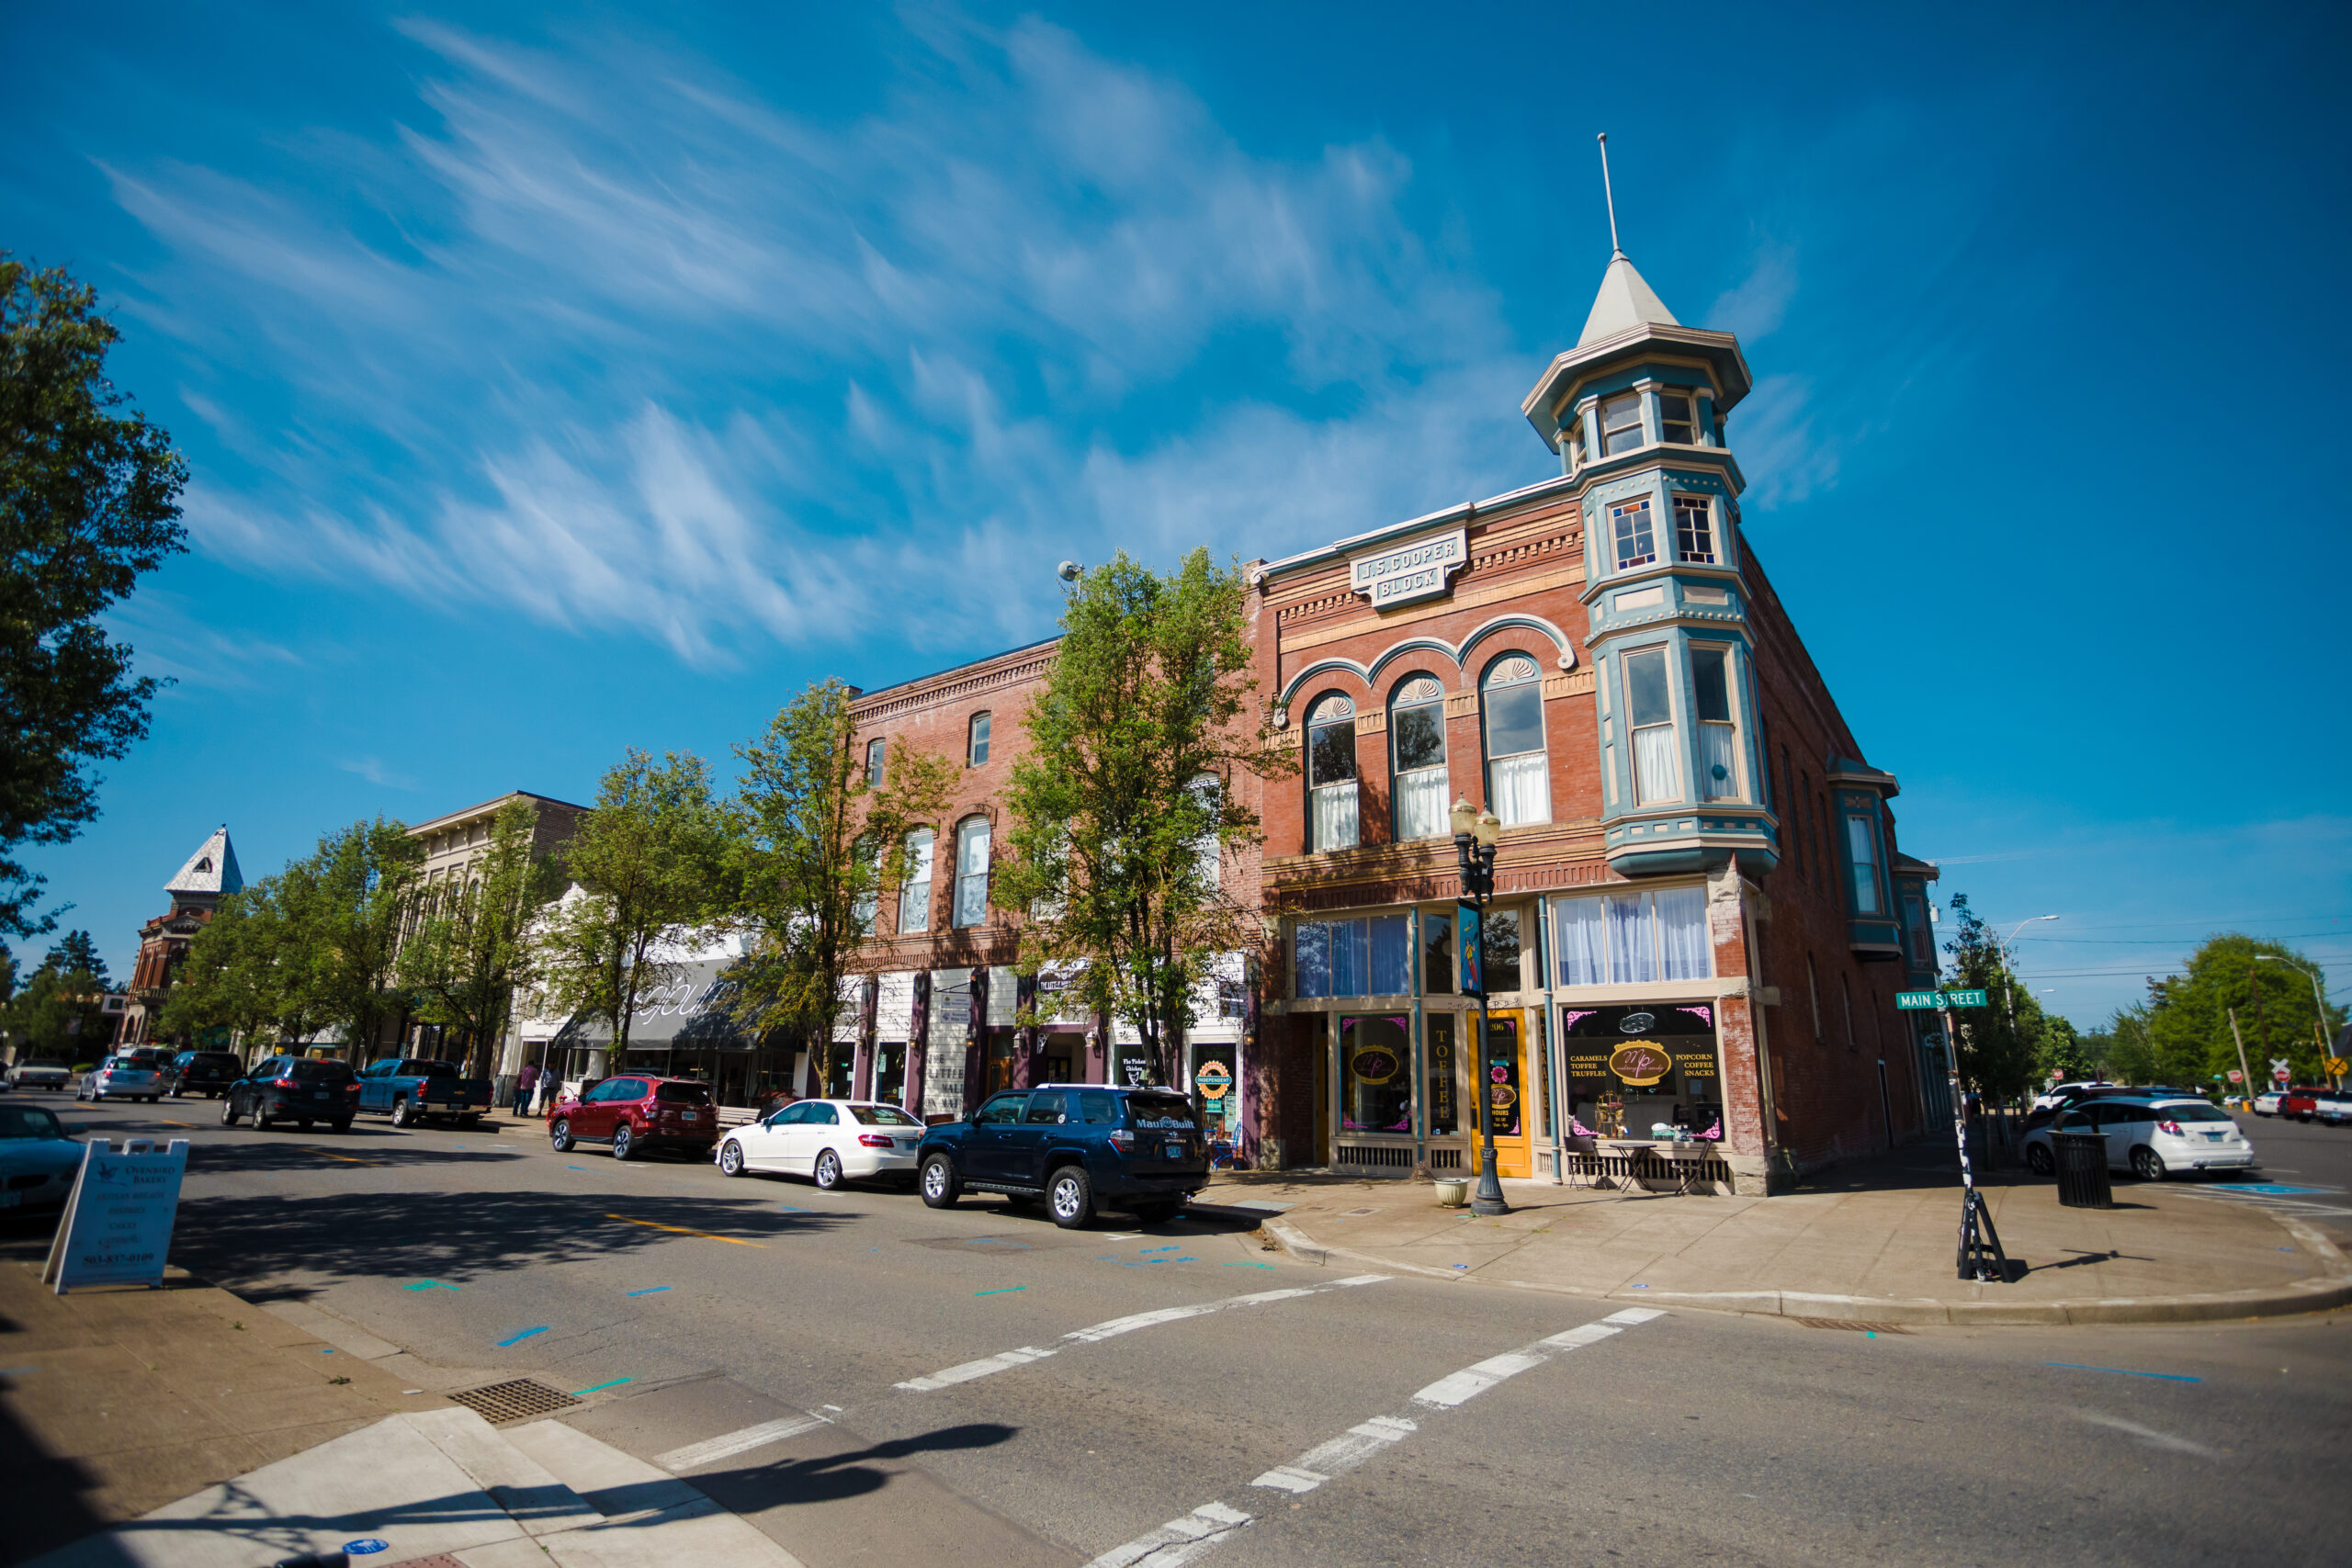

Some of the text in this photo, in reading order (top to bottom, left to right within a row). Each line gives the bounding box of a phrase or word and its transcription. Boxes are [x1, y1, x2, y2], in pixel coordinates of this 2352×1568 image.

[1381, 570, 1435, 597] BLOCK
[1901, 992, 1981, 1007] MAIN STREET
[928, 1068, 964, 1079] LITTLE
[1436, 1030, 1450, 1119] TOFFEE
[1173, 1119, 1195, 1129] Built
[133, 1176, 168, 1184] BAKERY
